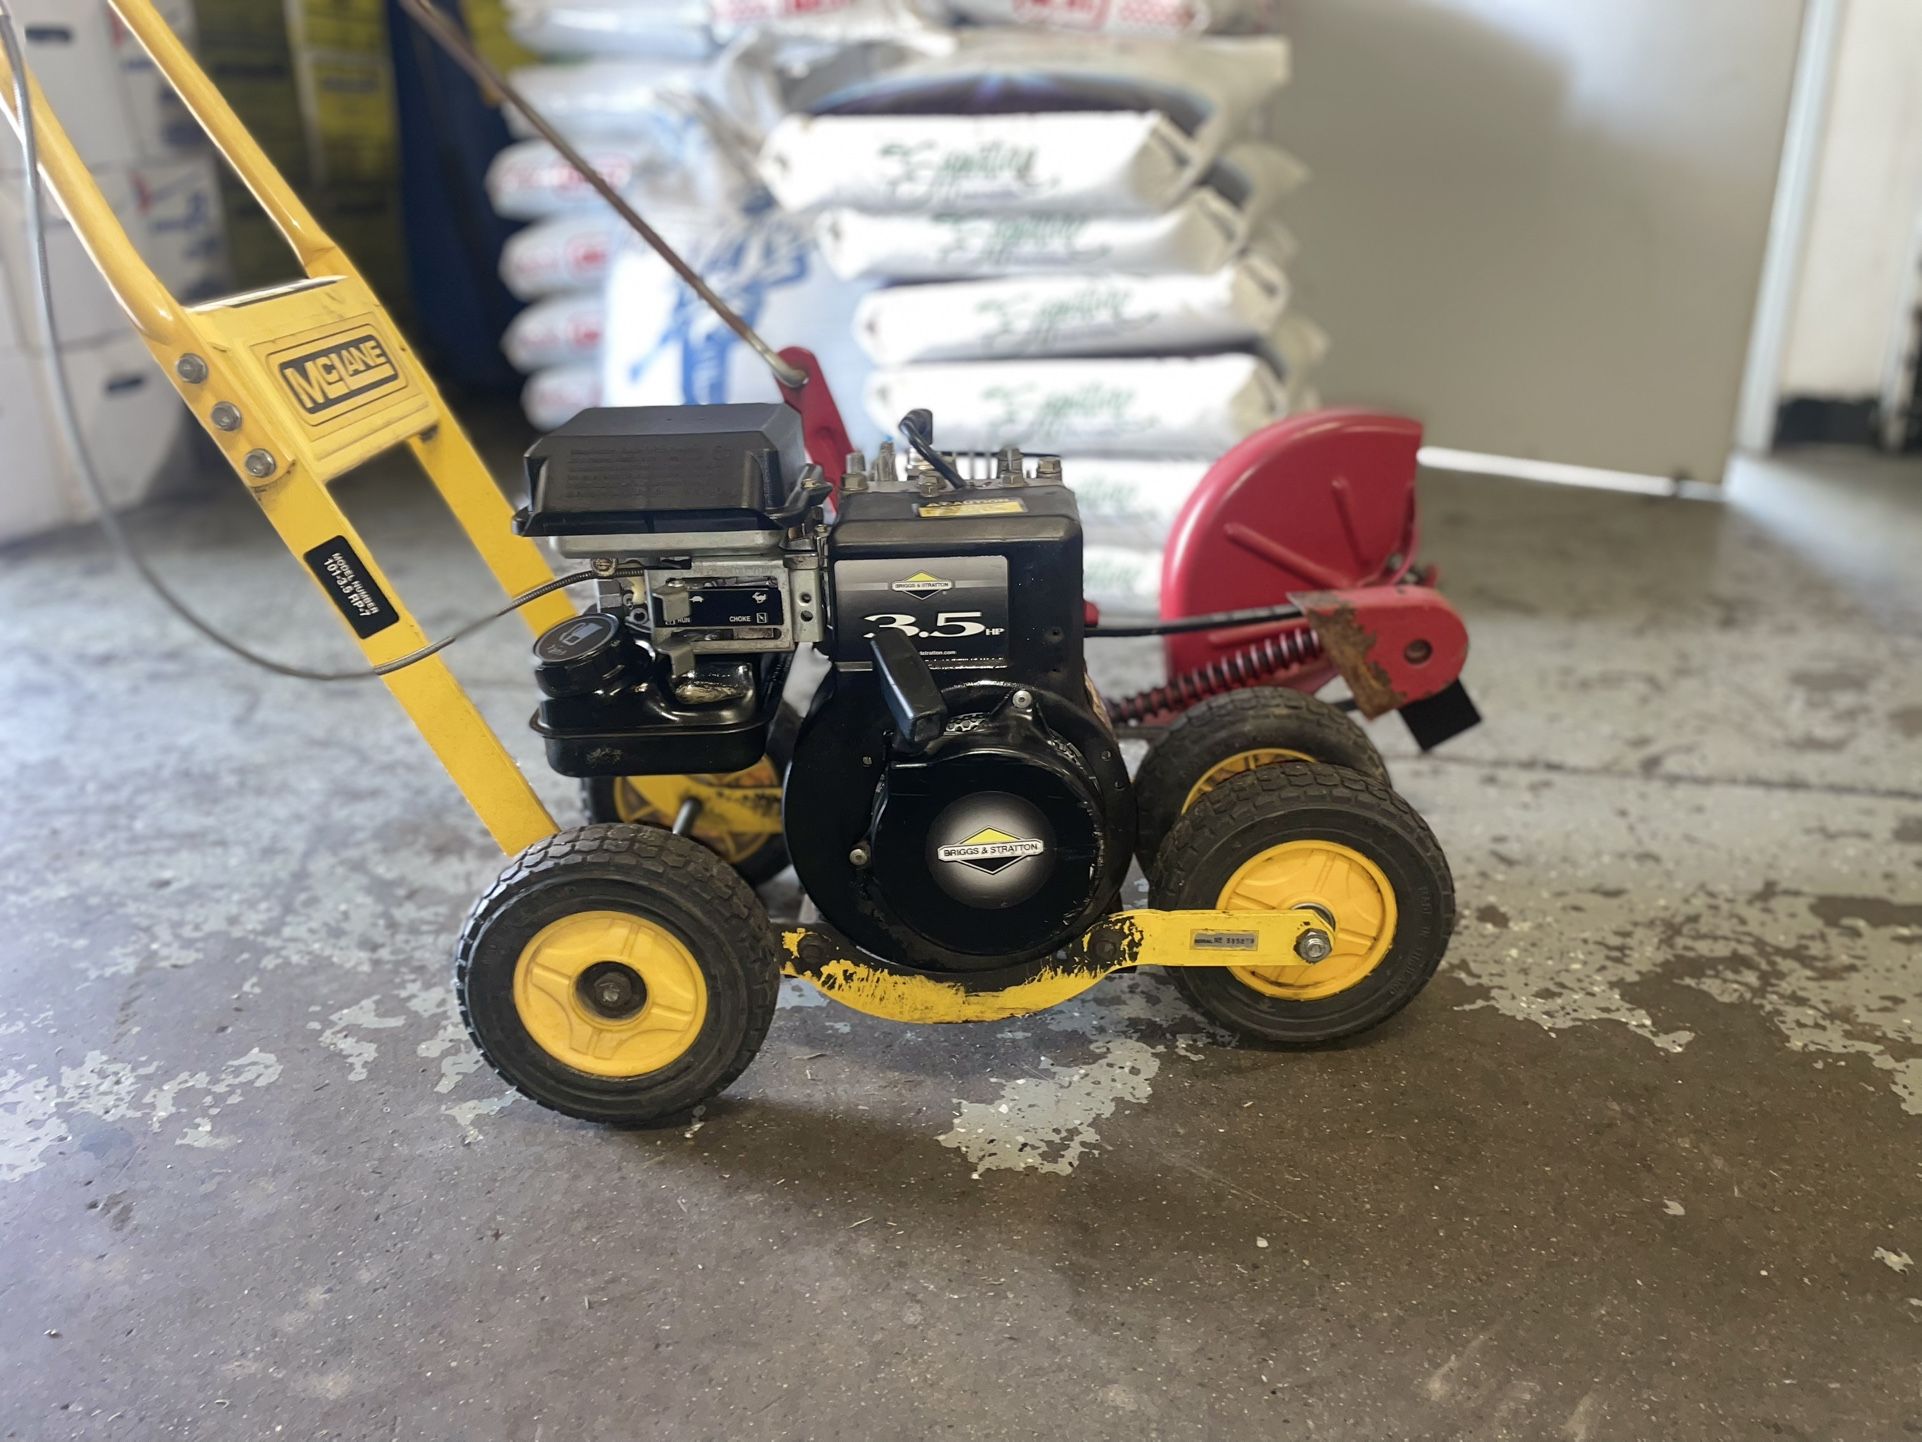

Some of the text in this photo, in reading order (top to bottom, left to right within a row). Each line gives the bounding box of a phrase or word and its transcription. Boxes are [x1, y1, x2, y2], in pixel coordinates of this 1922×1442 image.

[331, 552, 380, 614] MODEL NUMBER
[863, 611, 1005, 639] 3.5 HP
[943, 843, 1038, 857] BRIGGS & STRATTON
